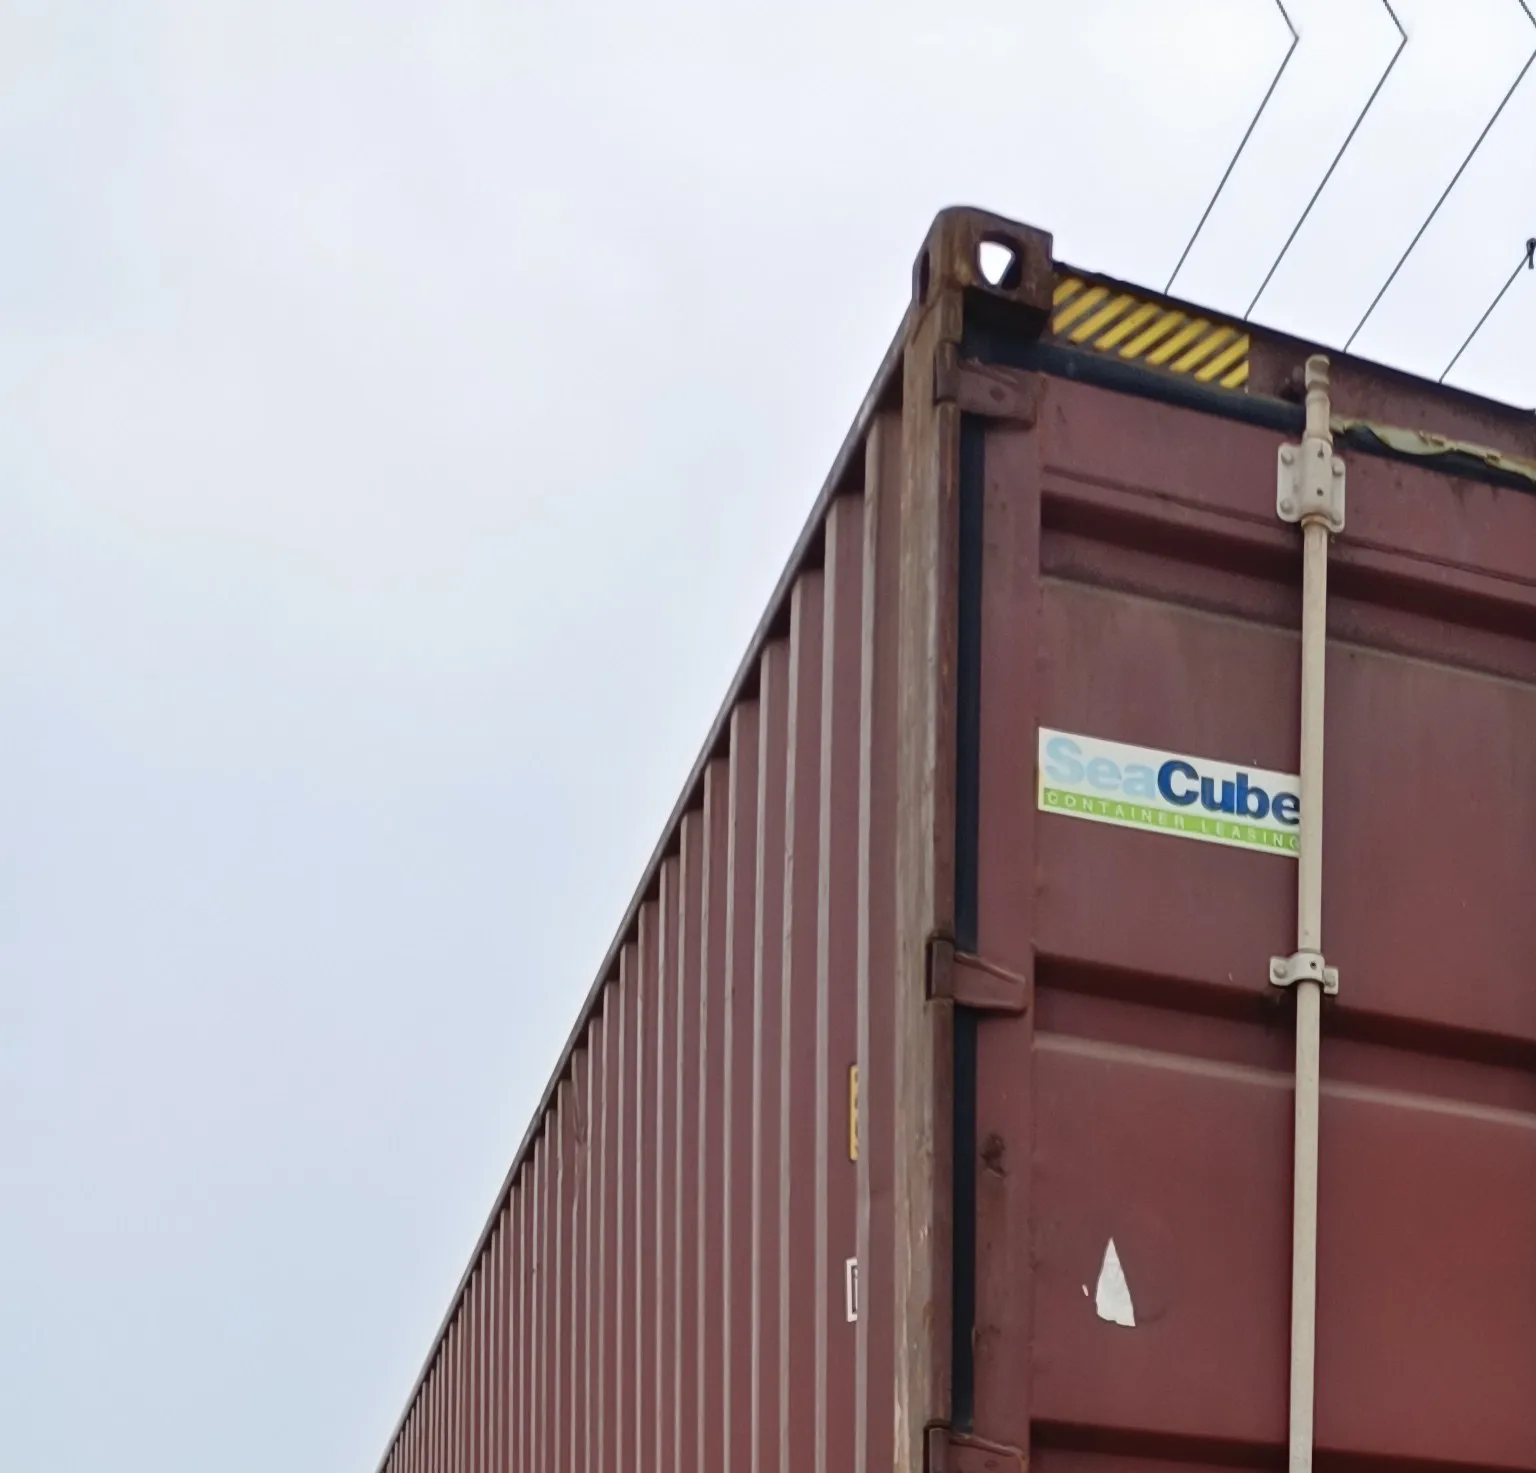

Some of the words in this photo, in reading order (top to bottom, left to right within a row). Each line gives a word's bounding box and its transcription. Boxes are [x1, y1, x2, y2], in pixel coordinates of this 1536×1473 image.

[1045, 736, 1300, 826] SeaCube
[1046, 790, 1186, 831] CONTAINER
[1201, 817, 1300, 850] LEASING
